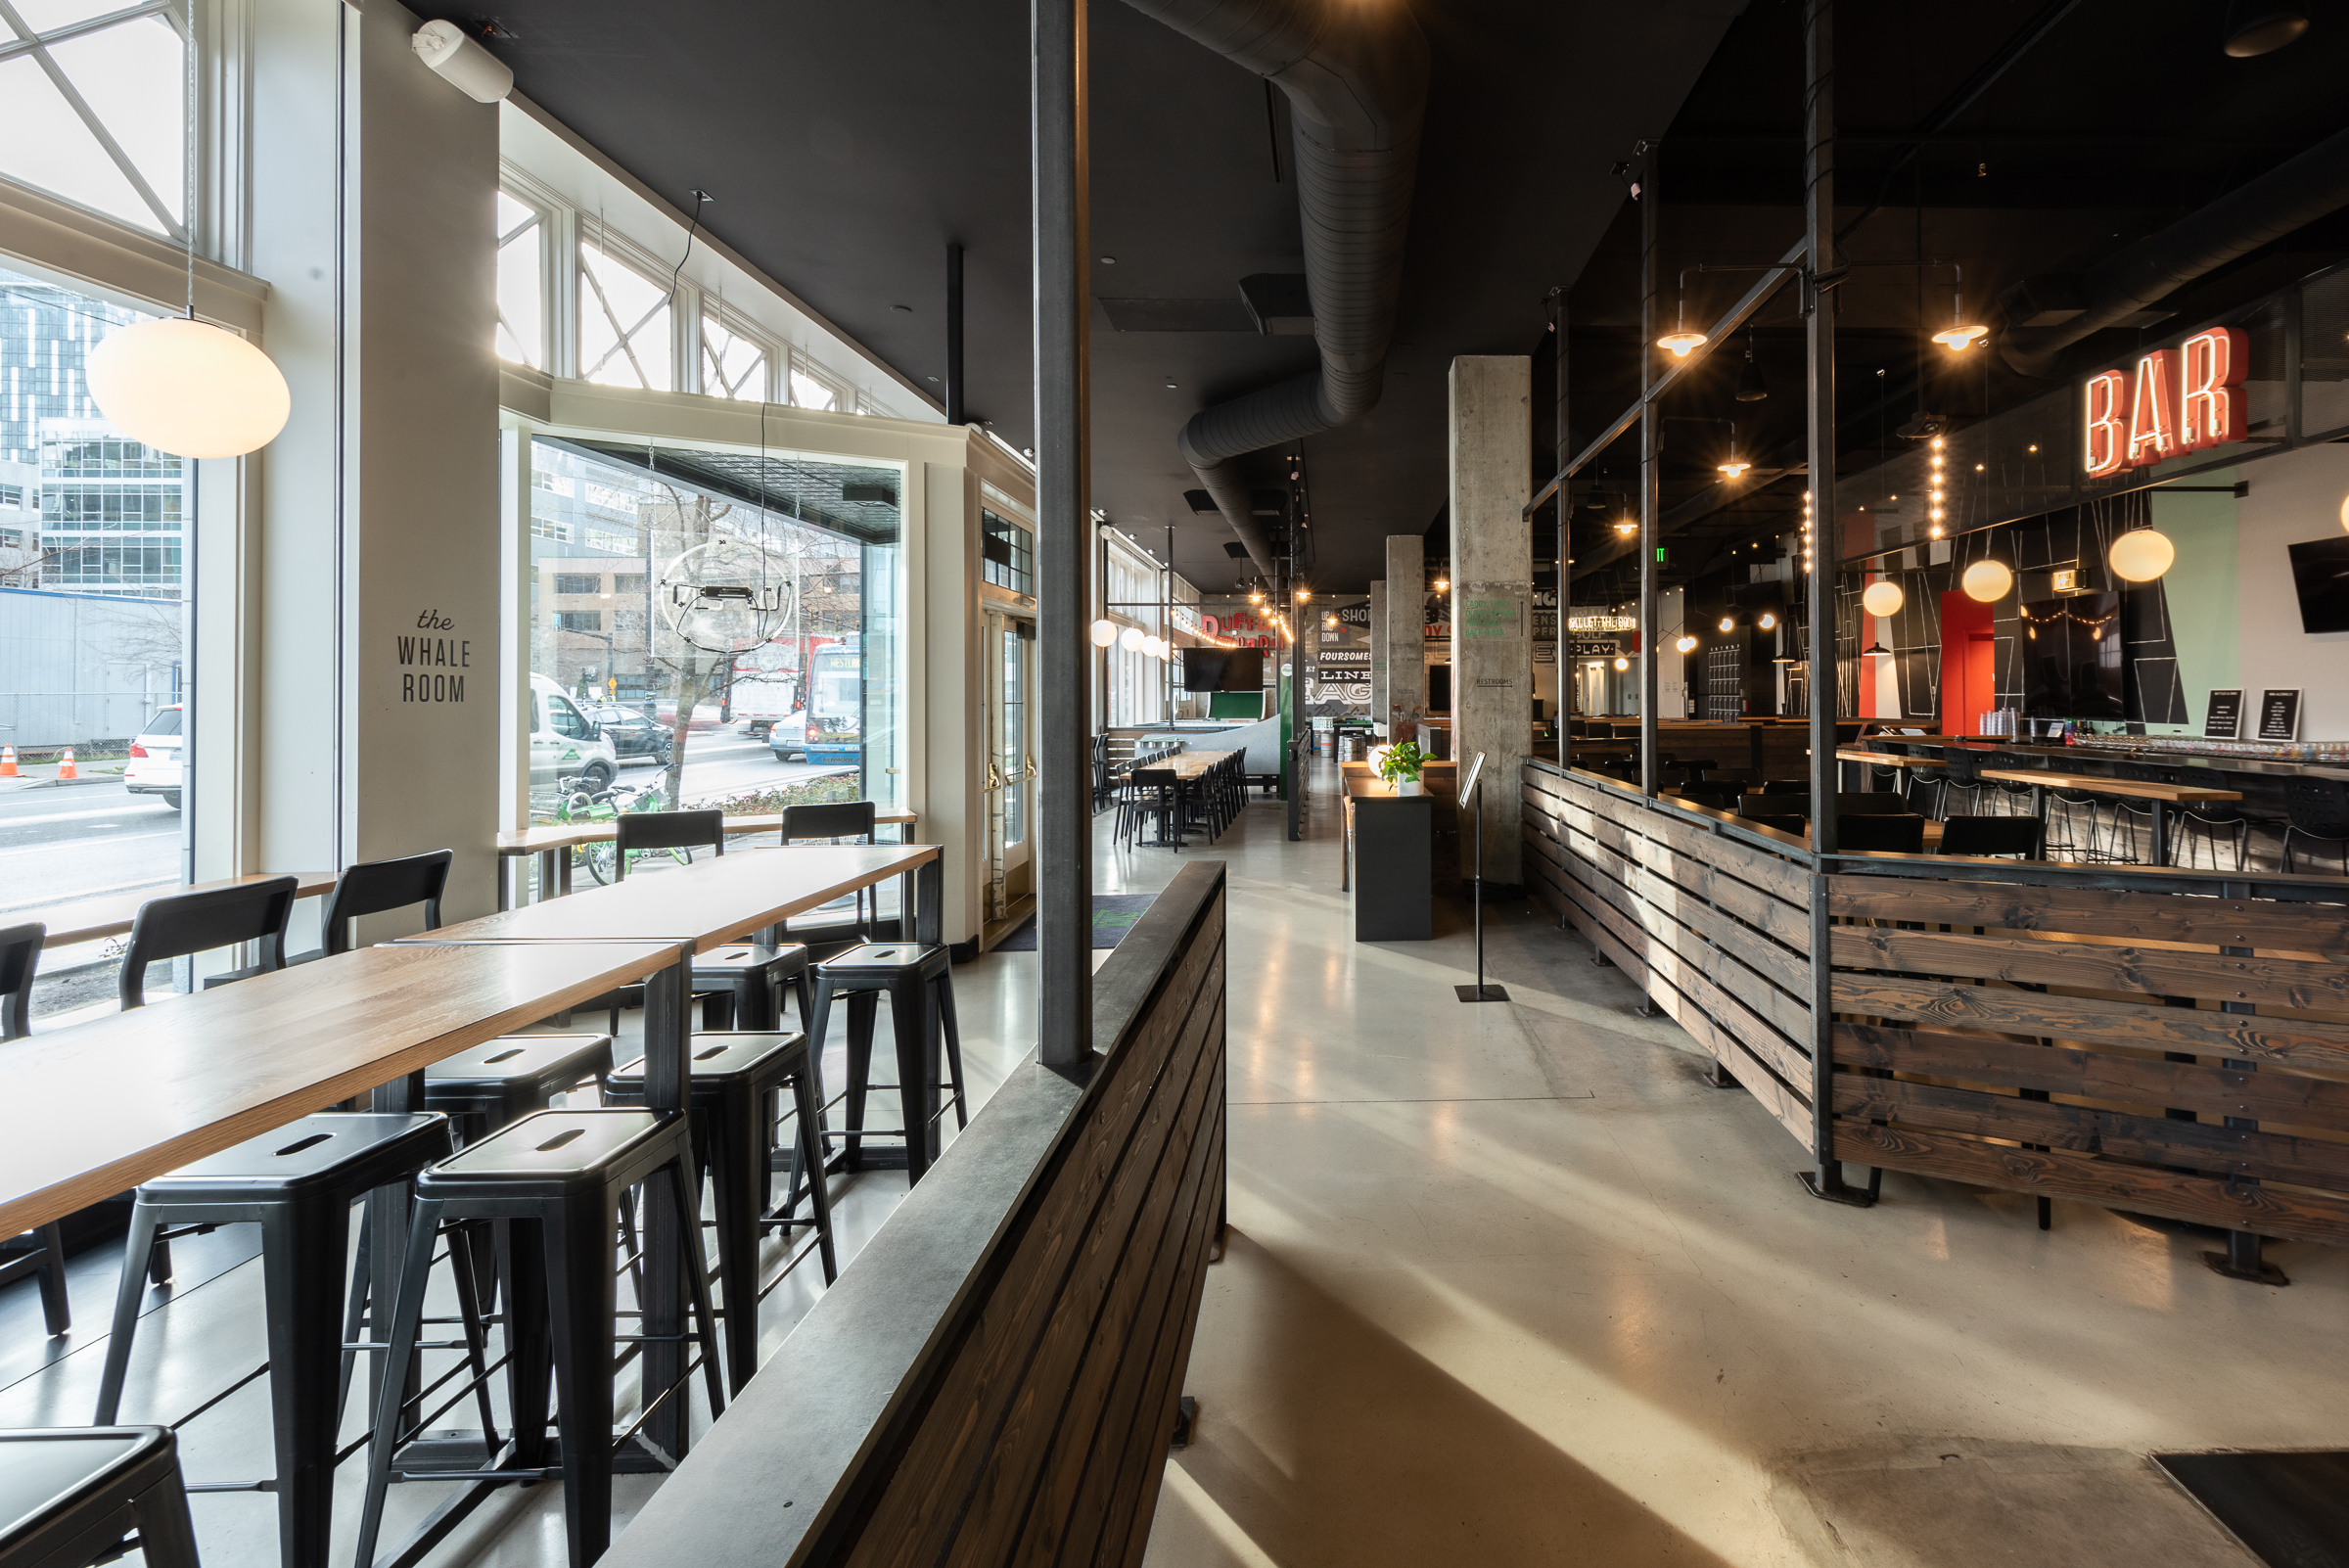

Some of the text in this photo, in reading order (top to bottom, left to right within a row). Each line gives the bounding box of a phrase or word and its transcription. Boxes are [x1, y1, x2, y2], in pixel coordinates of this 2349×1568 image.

[2085, 327, 2248, 480] BAR
[1656, 547, 1665, 563] IT
[1533, 591, 1557, 607] NG
[417, 609, 454, 630] the
[1321, 611, 1330, 621] UP
[1533, 615, 1557, 625] ENS
[1321, 632, 1339, 642] DOWN
[1492, 628, 1504, 637] BAR
[1533, 627, 1557, 637] PER
[397, 635, 470, 668] WHALE
[1575, 644, 1610, 654] PLAY
[830, 658, 860, 669] WESTLAK
[403, 673, 464, 702] ROOM
